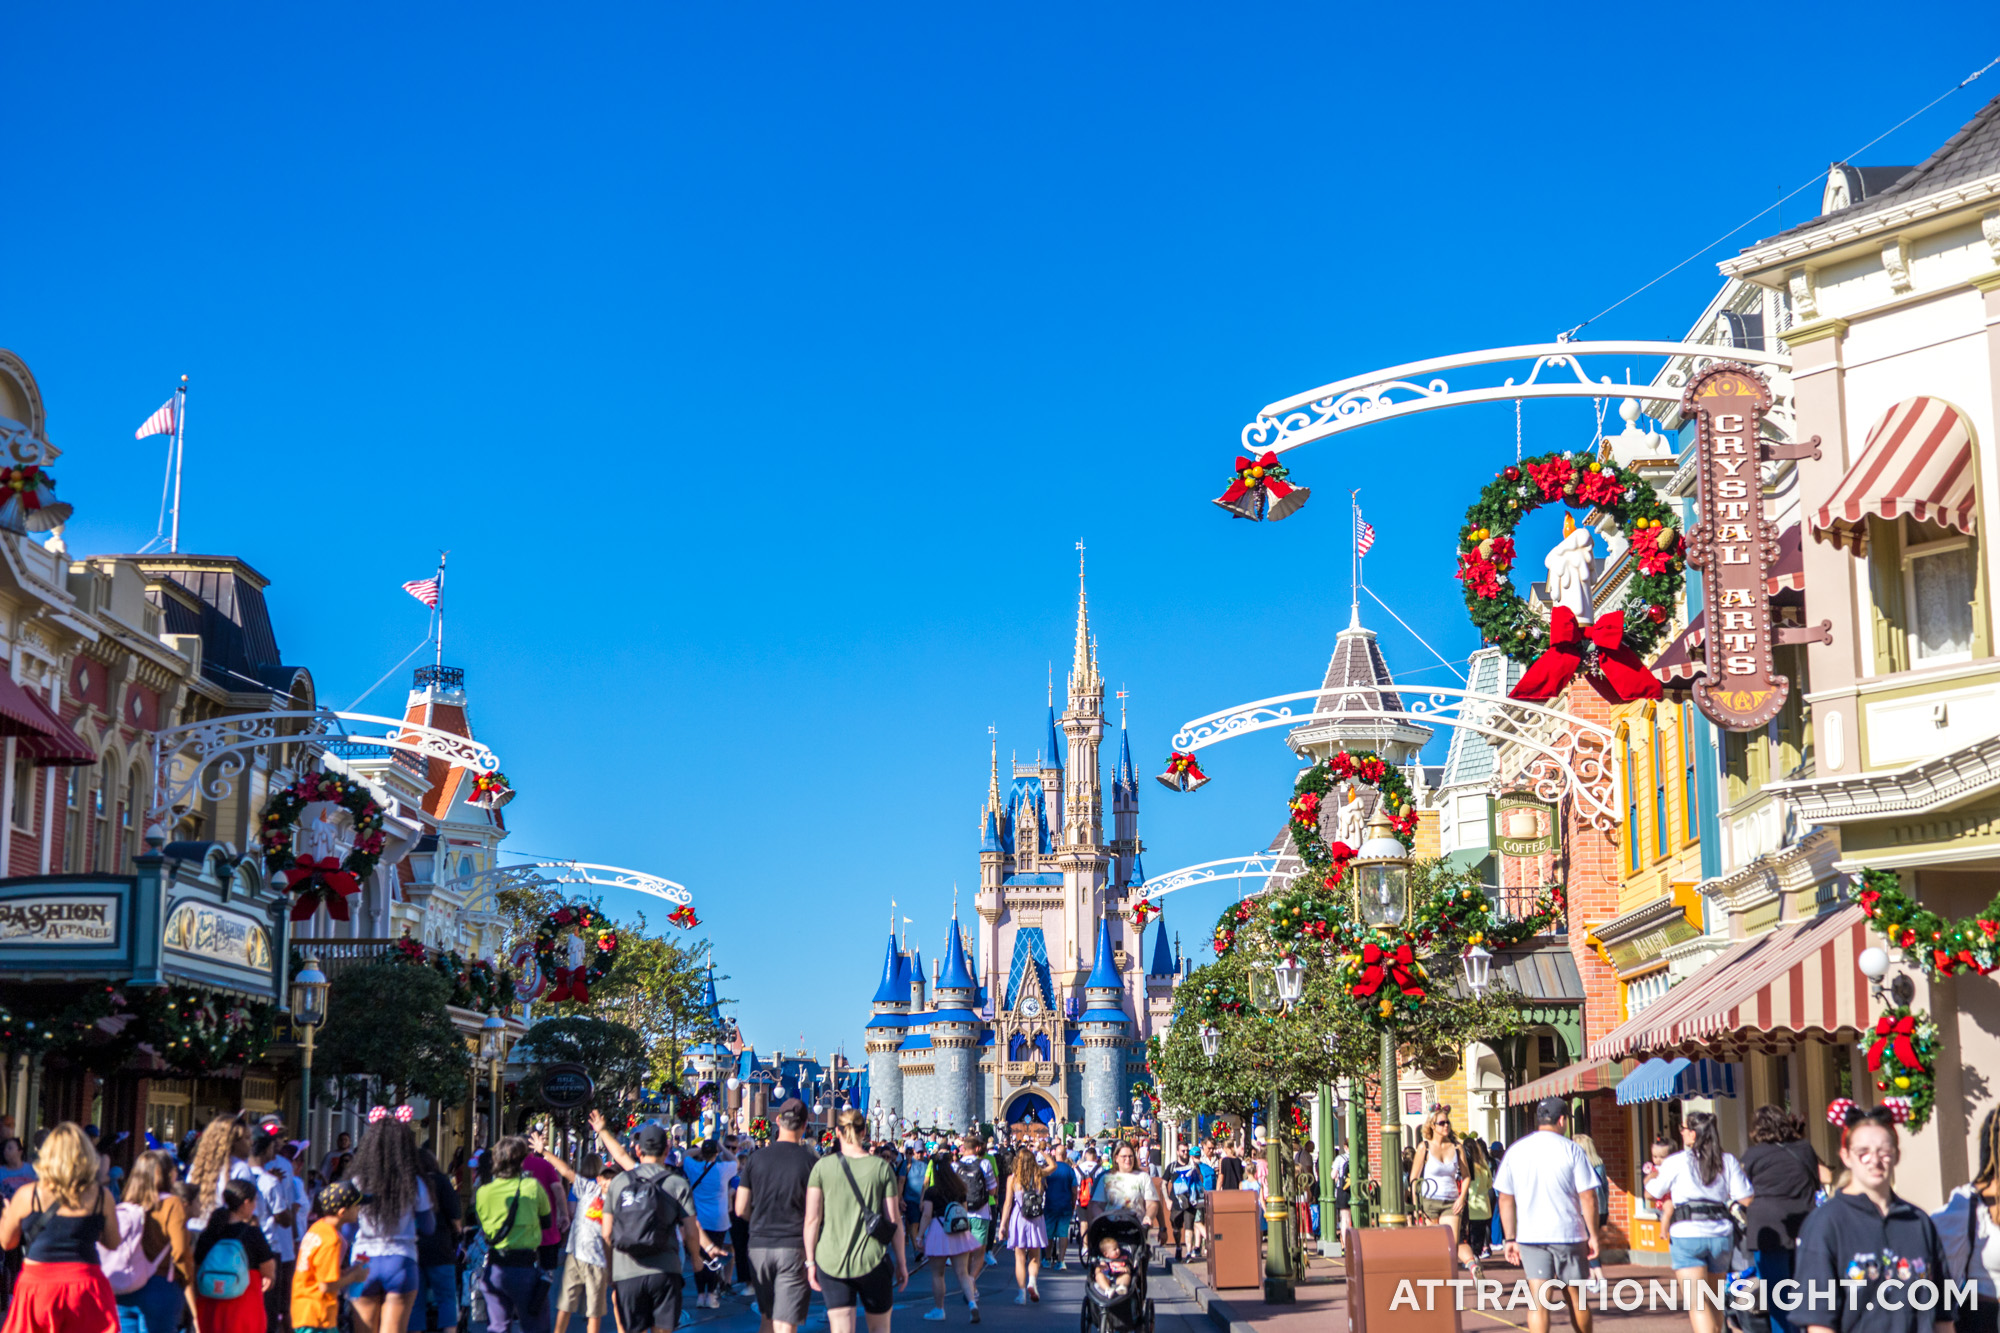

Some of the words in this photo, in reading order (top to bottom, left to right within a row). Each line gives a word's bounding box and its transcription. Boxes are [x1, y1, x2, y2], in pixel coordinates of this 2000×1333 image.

[1714, 414, 1751, 565] CRYSTAL
[1721, 588, 1757, 676] ARTS
[1500, 796, 1518, 808] FRESH
[1503, 840, 1547, 854] COFFEE
[45, 924, 112, 940] APPAREL
[1632, 927, 1672, 961] BAKERY
